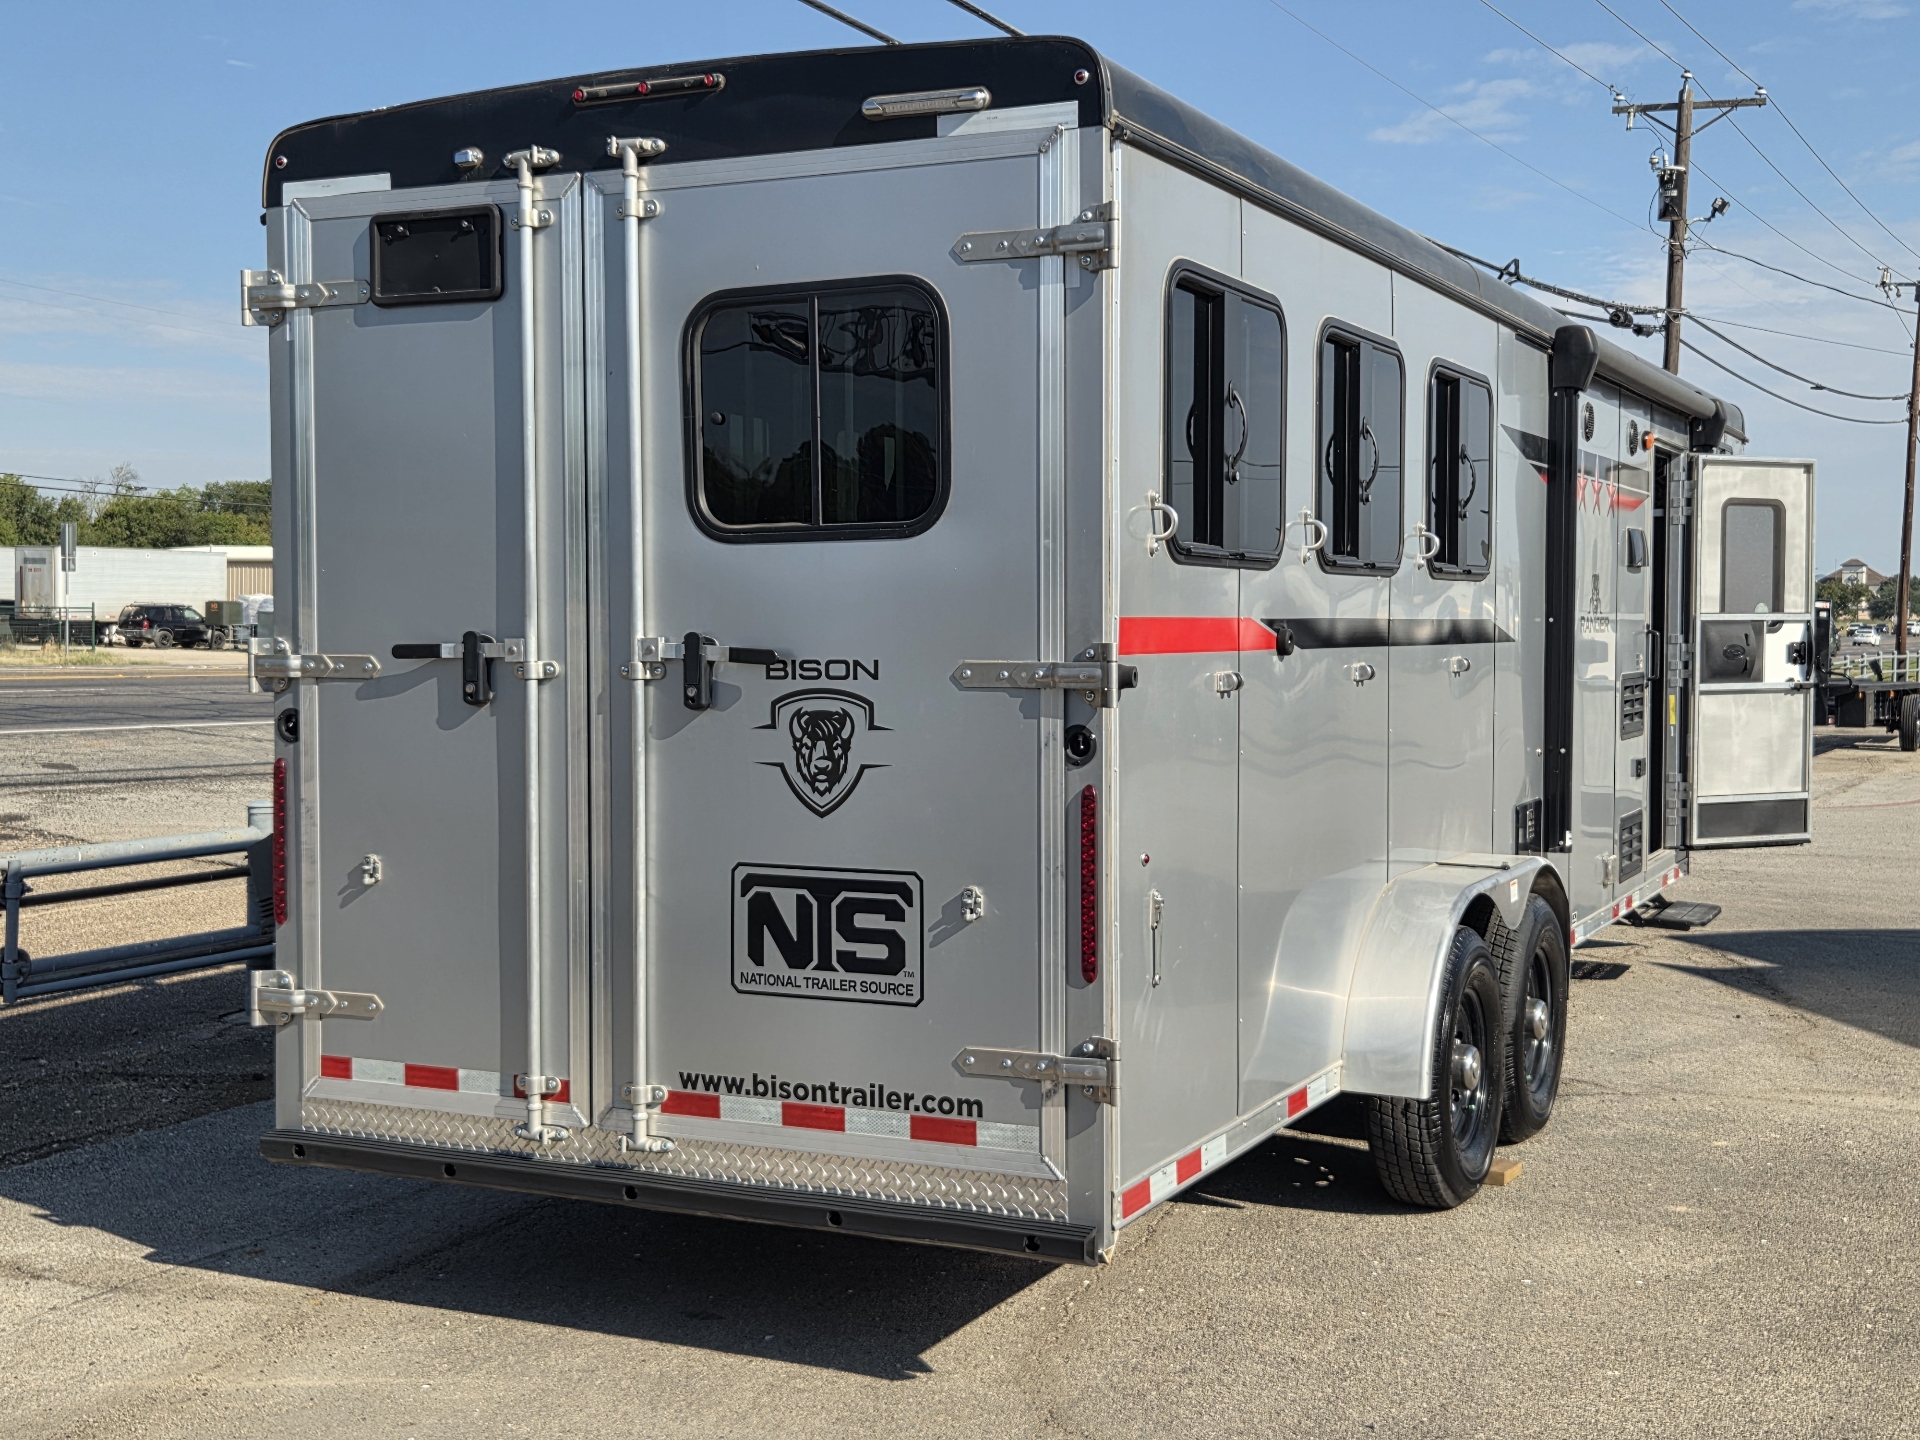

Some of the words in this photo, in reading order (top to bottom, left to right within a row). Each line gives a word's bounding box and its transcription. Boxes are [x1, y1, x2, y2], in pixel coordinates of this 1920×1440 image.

[765, 659, 879, 681] BISON
[740, 873, 914, 976] NTS
[740, 971, 802, 988] NATIONAL
[804, 976, 858, 992] TRAILER
[860, 980, 914, 997] SOURCE
[679, 1071, 984, 1118] www.bisontrailer.com
